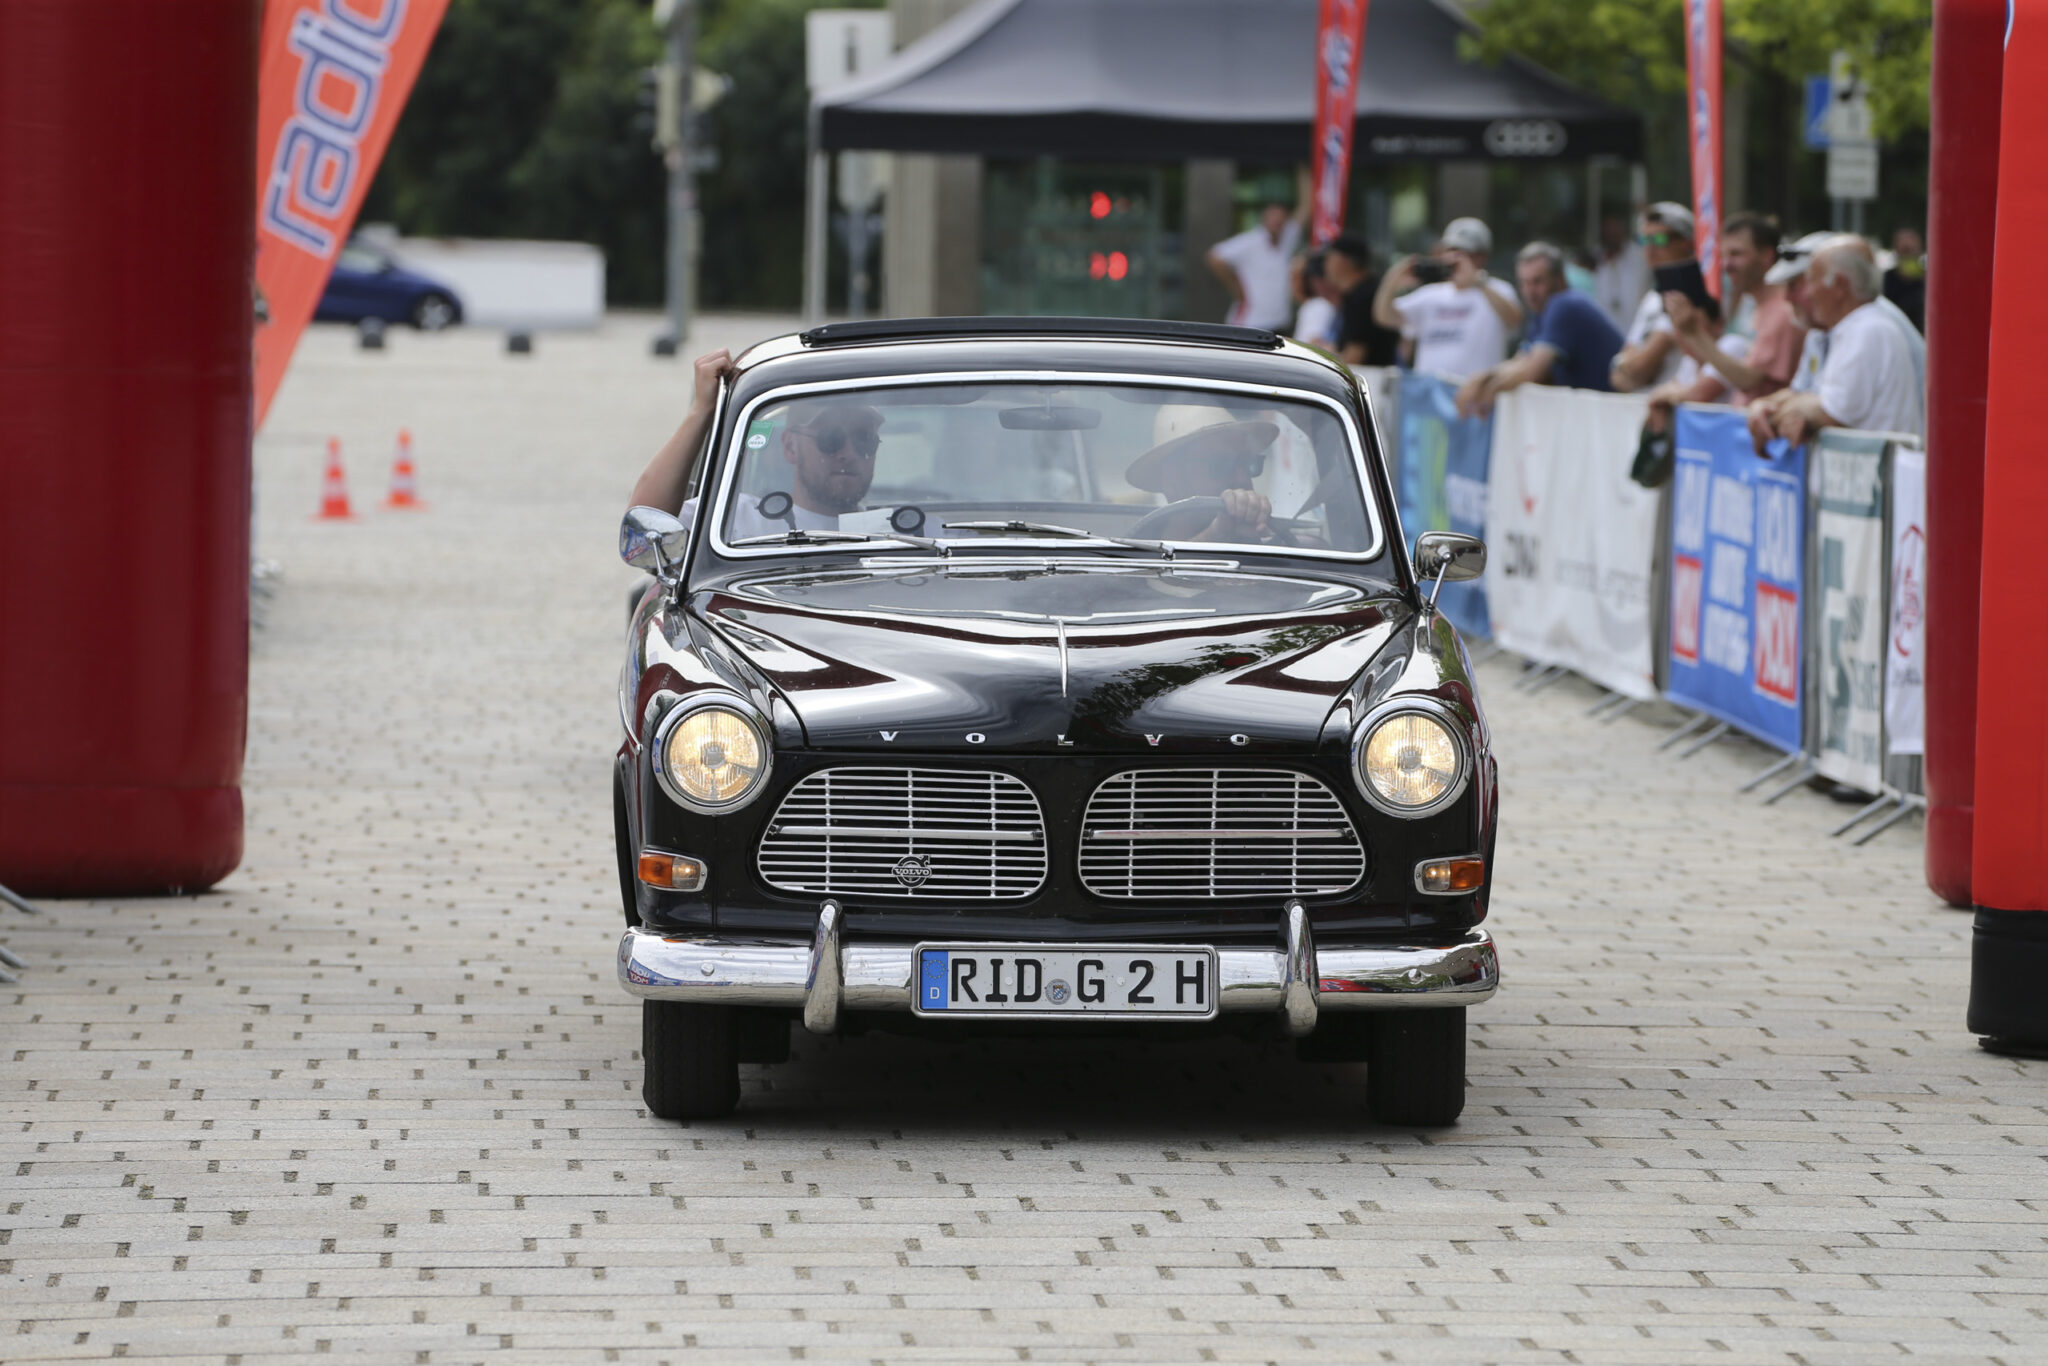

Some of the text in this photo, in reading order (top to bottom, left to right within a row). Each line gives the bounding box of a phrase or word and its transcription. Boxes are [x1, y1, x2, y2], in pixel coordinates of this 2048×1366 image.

[879, 730, 1250, 746] VOLVO
[894, 868, 930, 876] VOLVO
[951, 958, 1205, 1005] RID G 2 H
[929, 987, 940, 1000] D
